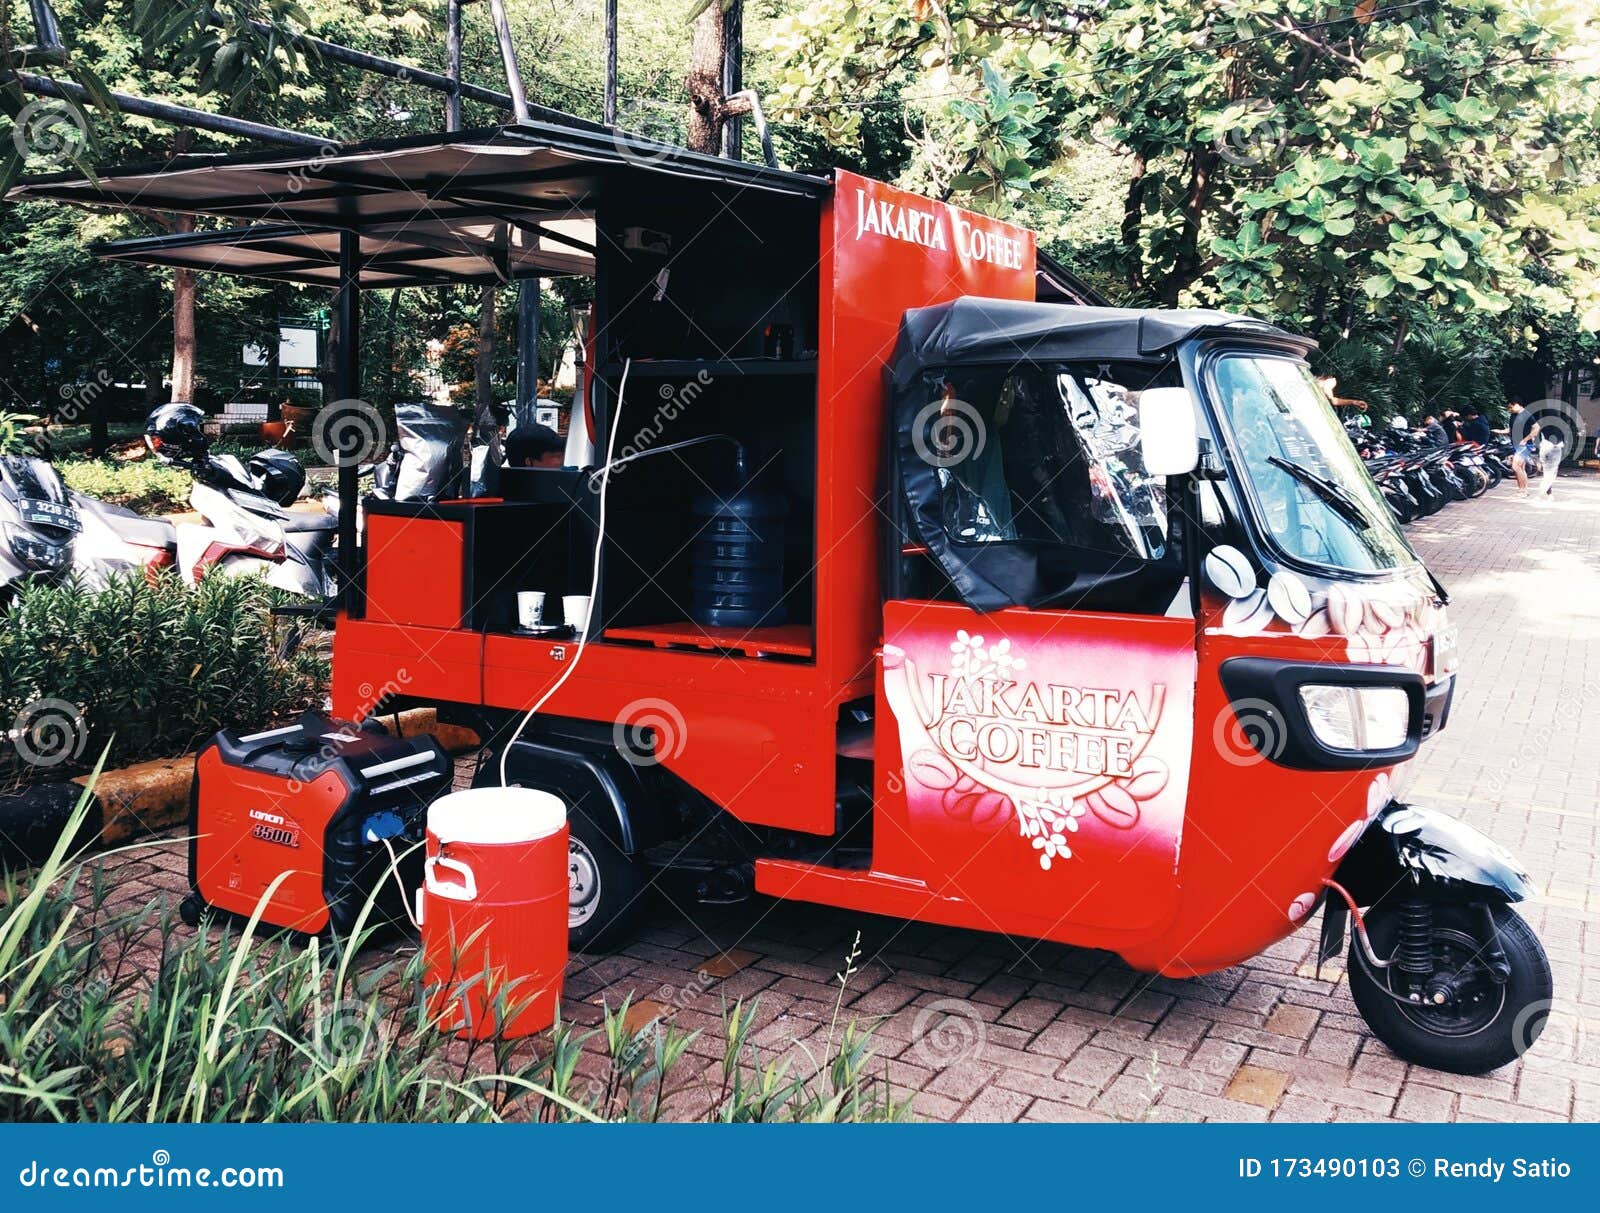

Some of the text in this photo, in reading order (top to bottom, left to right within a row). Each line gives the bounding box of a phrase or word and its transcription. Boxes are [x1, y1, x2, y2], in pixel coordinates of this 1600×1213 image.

[855, 188, 1022, 271] JAKARTA COFFEE
[926, 673, 1156, 735] JAKARTA
[938, 715, 1134, 778] COFFEE
